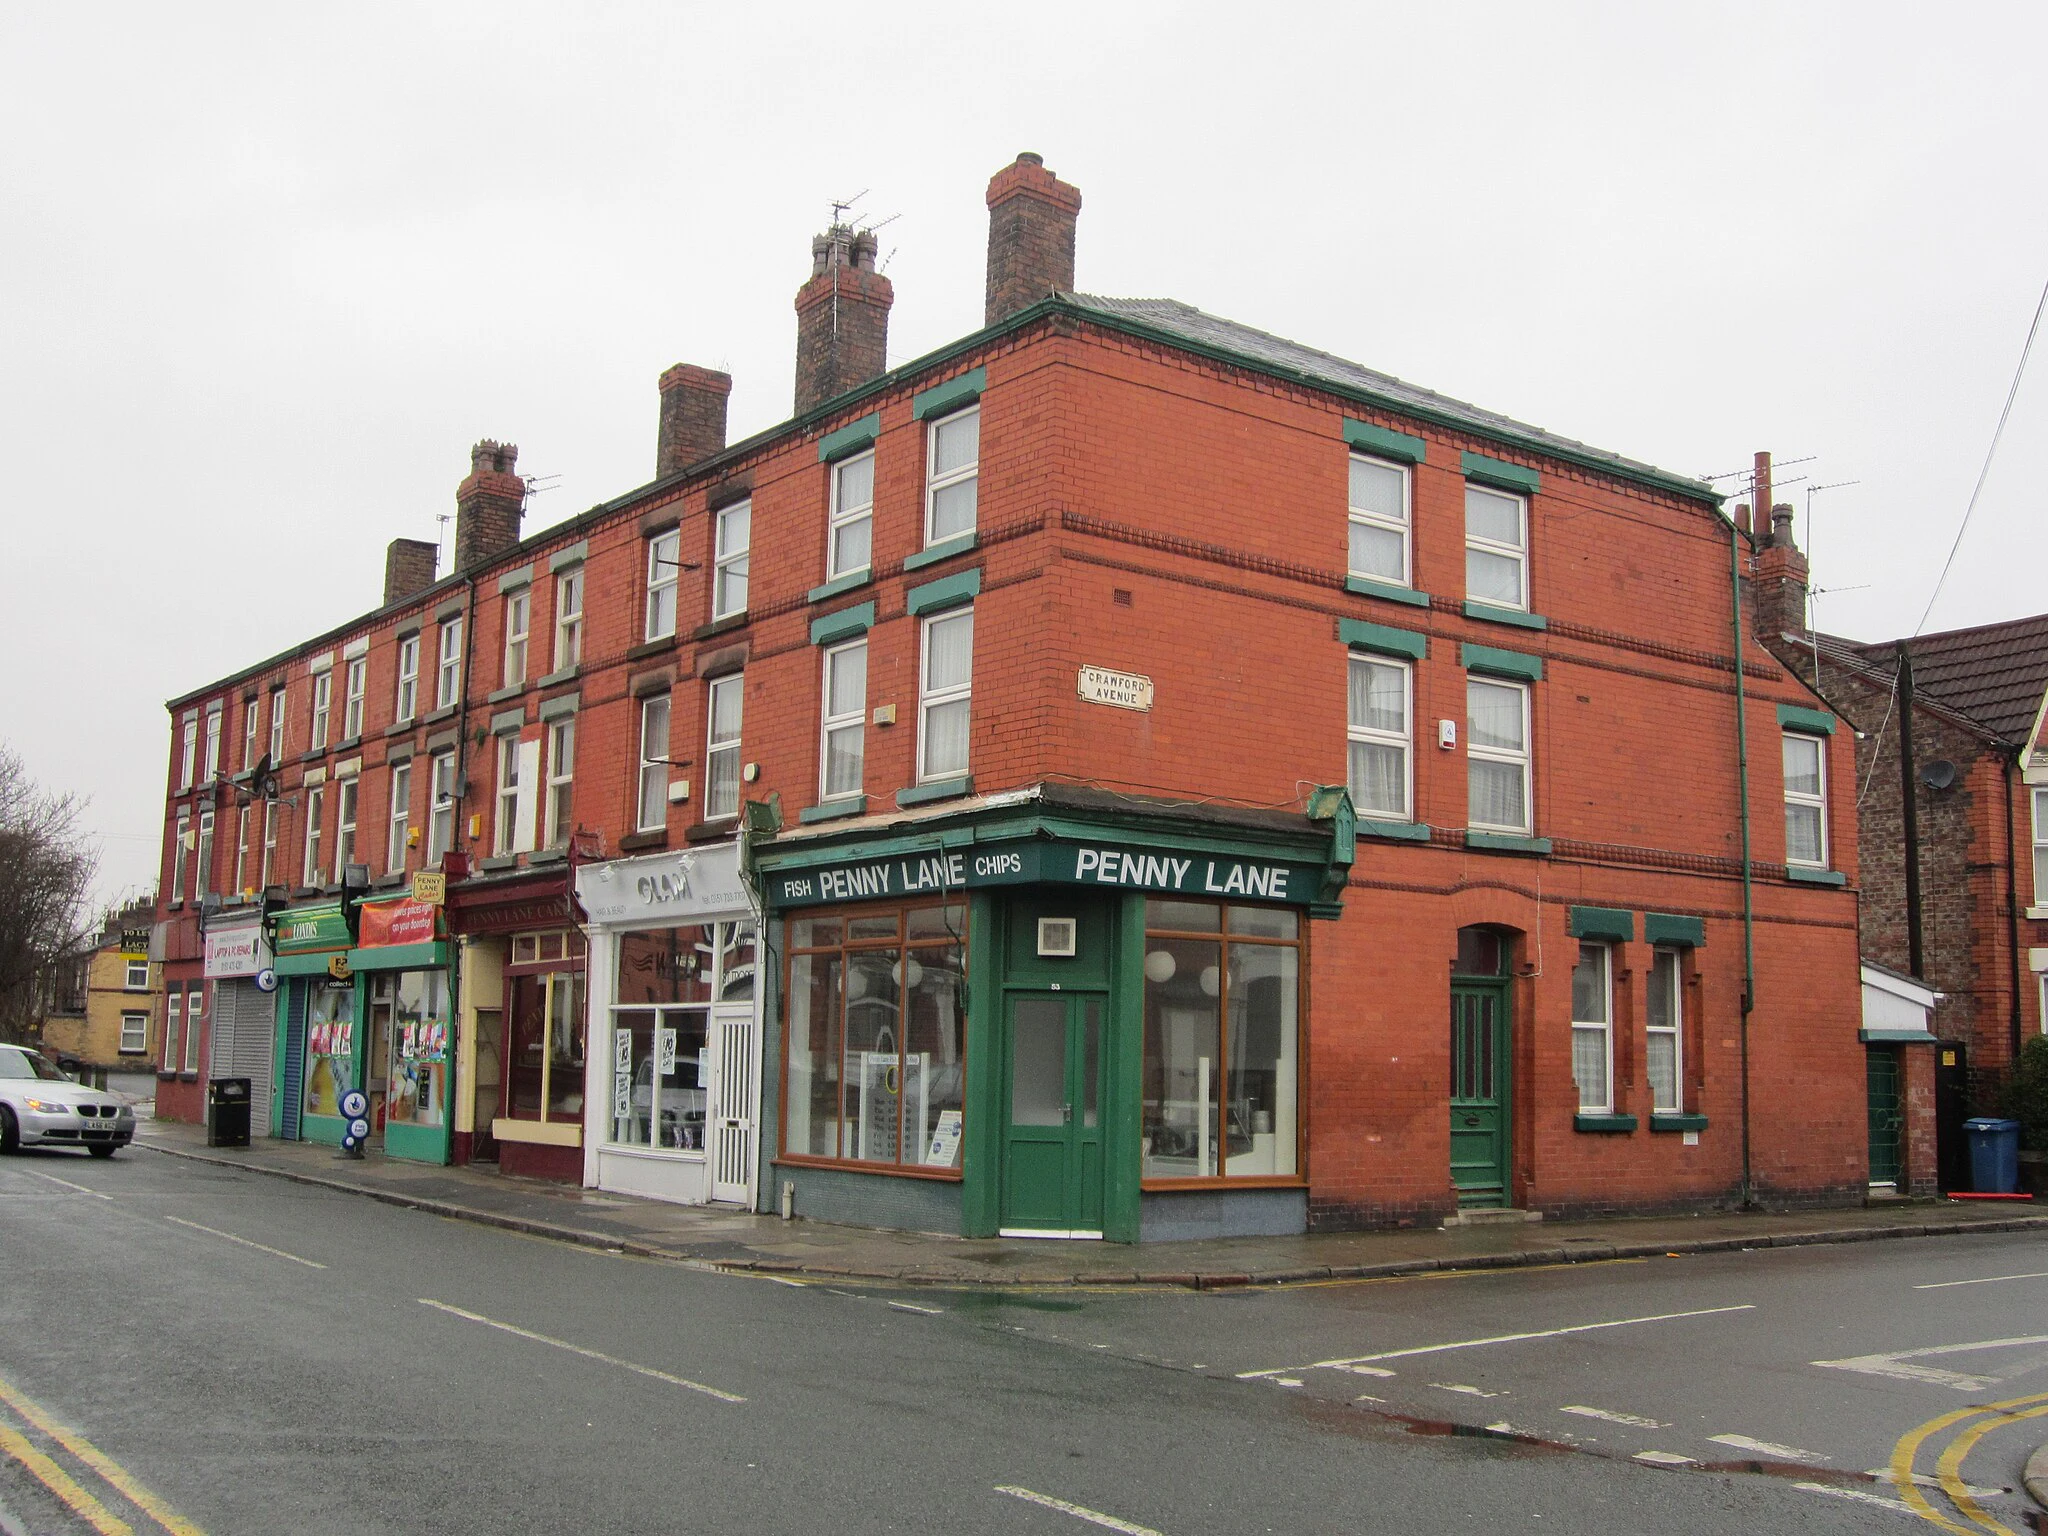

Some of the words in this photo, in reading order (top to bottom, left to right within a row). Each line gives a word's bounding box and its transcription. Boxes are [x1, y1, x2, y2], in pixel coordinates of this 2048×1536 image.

[1088, 672, 1145, 692] CRAWFORD
[1096, 687, 1137, 704] AVENUE
[784, 879, 812, 898] FISH
[819, 864, 890, 899] PENNY
[902, 854, 966, 890] LANE
[975, 853, 1022, 876] CHIPS
[1075, 848, 1192, 889] PENNY
[1205, 861, 1290, 898] LANE
[466, 910, 500, 924] PENNY
[504, 906, 533, 921] LANE
[123, 929, 135, 937] TO
